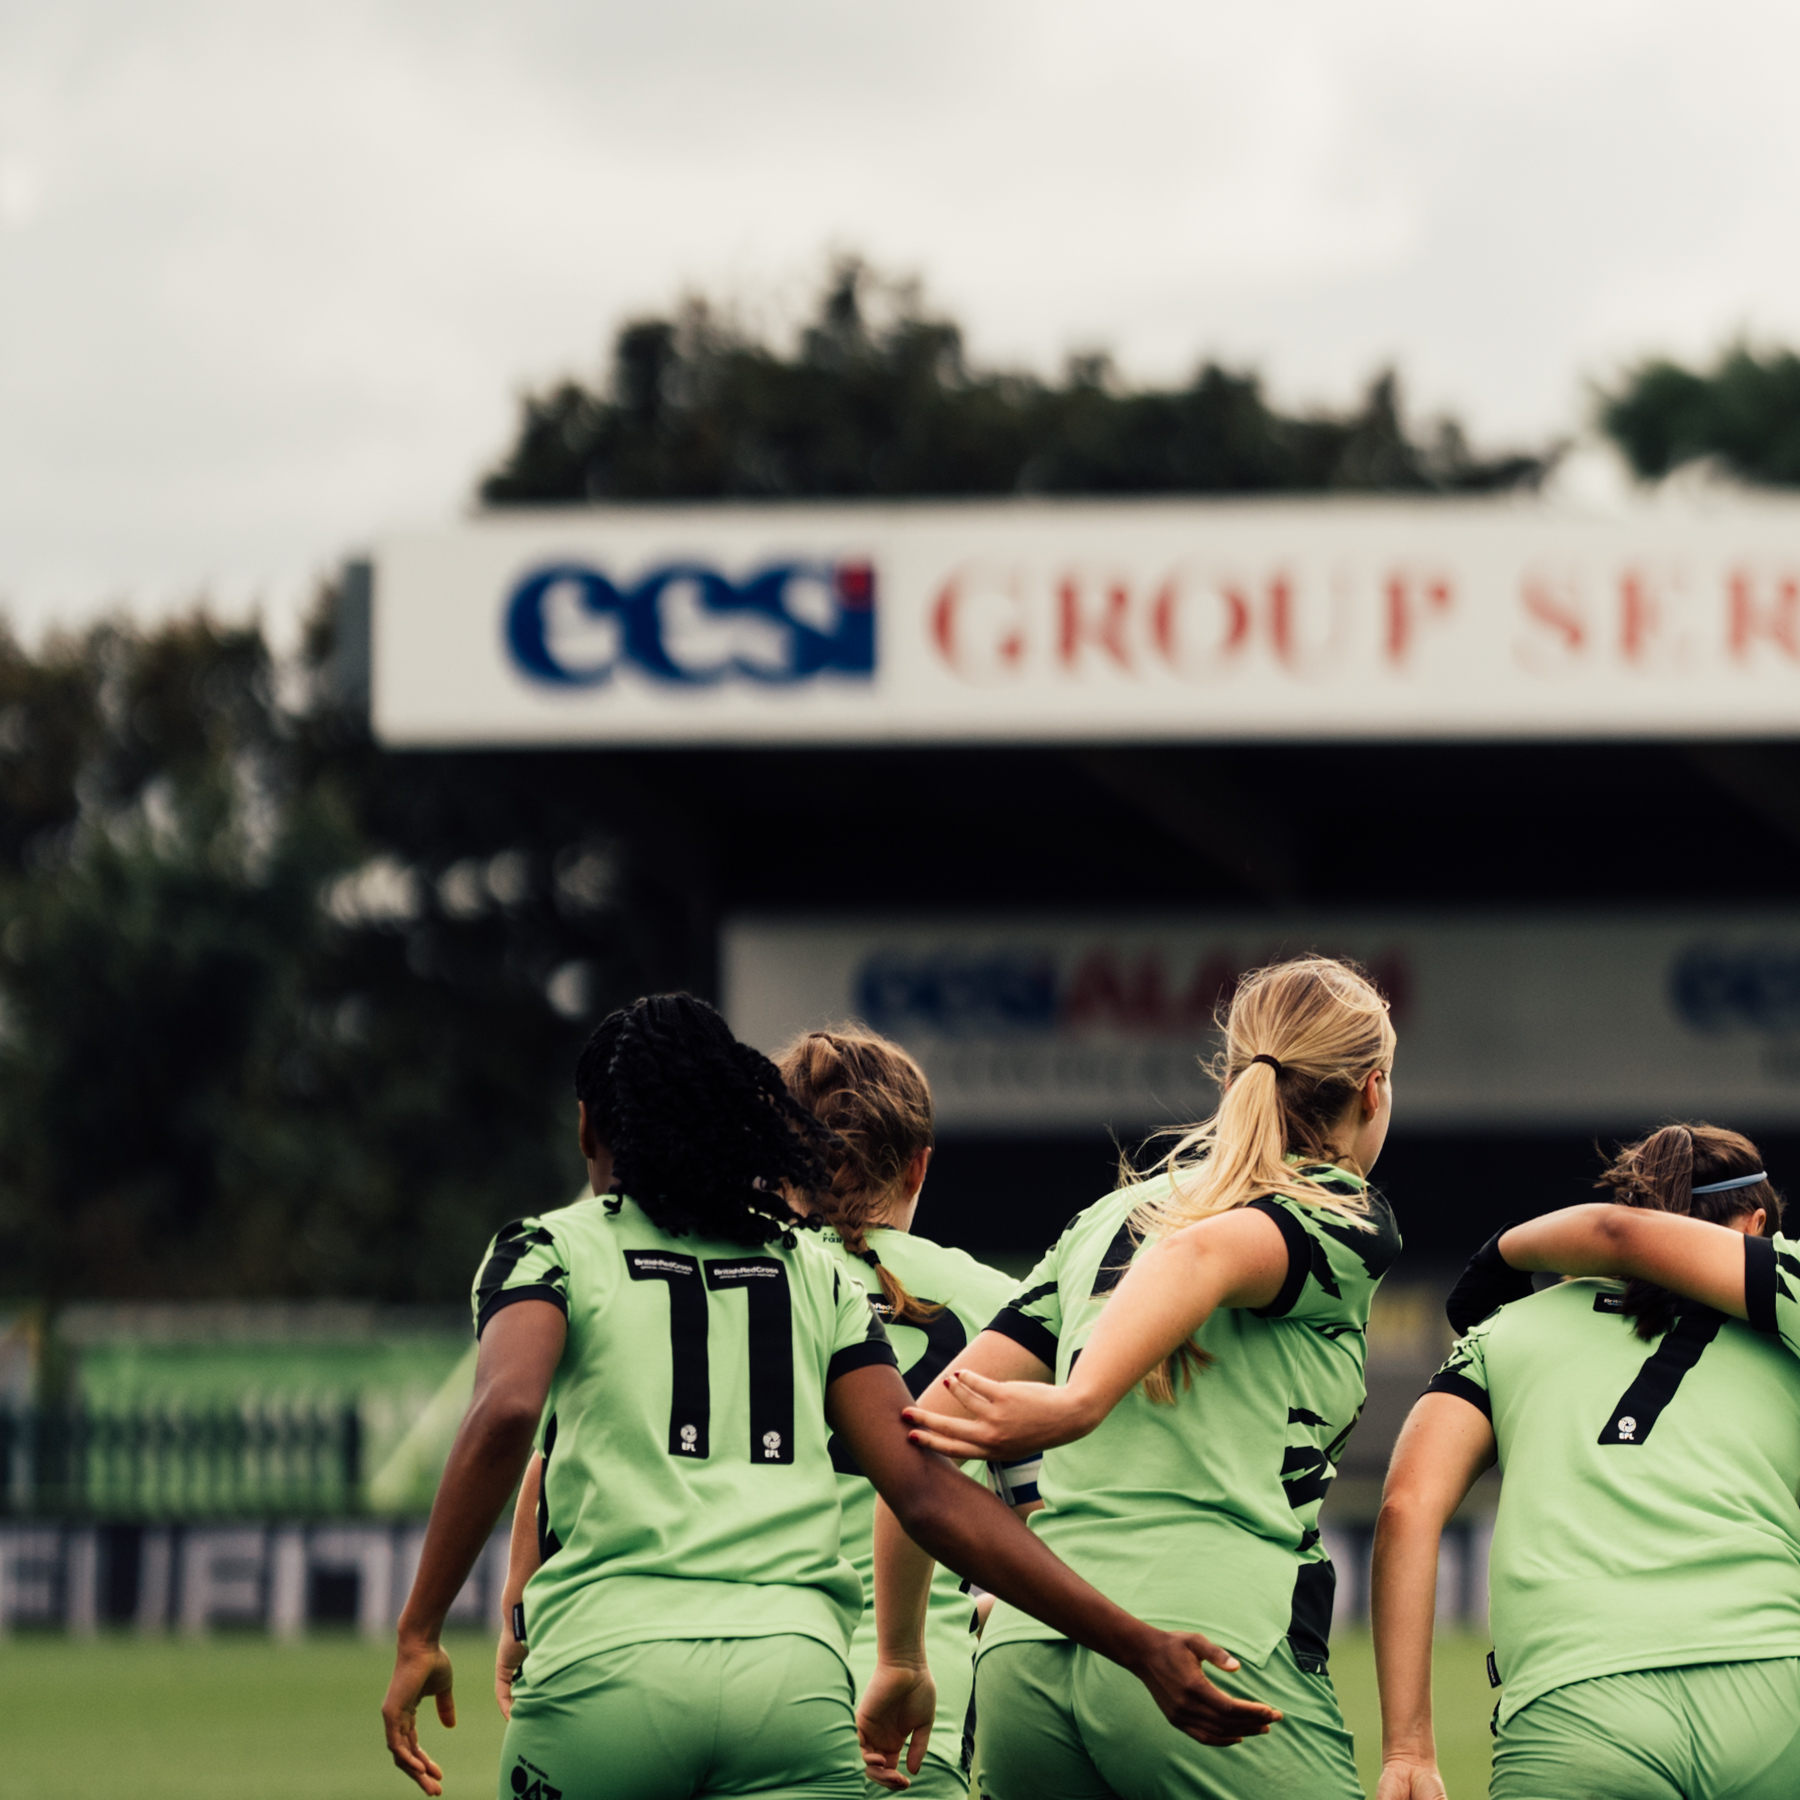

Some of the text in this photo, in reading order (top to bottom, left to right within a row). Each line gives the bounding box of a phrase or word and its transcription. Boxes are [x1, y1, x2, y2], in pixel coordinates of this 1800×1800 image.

[928, 558, 1460, 681] GROUP
[713, 1265, 779, 1276] BritishRedCross
[623, 1249, 794, 1465] 11
[1618, 1431, 1635, 1440] EFL
[681, 1441, 697, 1453] EFL
[764, 1449, 781, 1459] EFL
